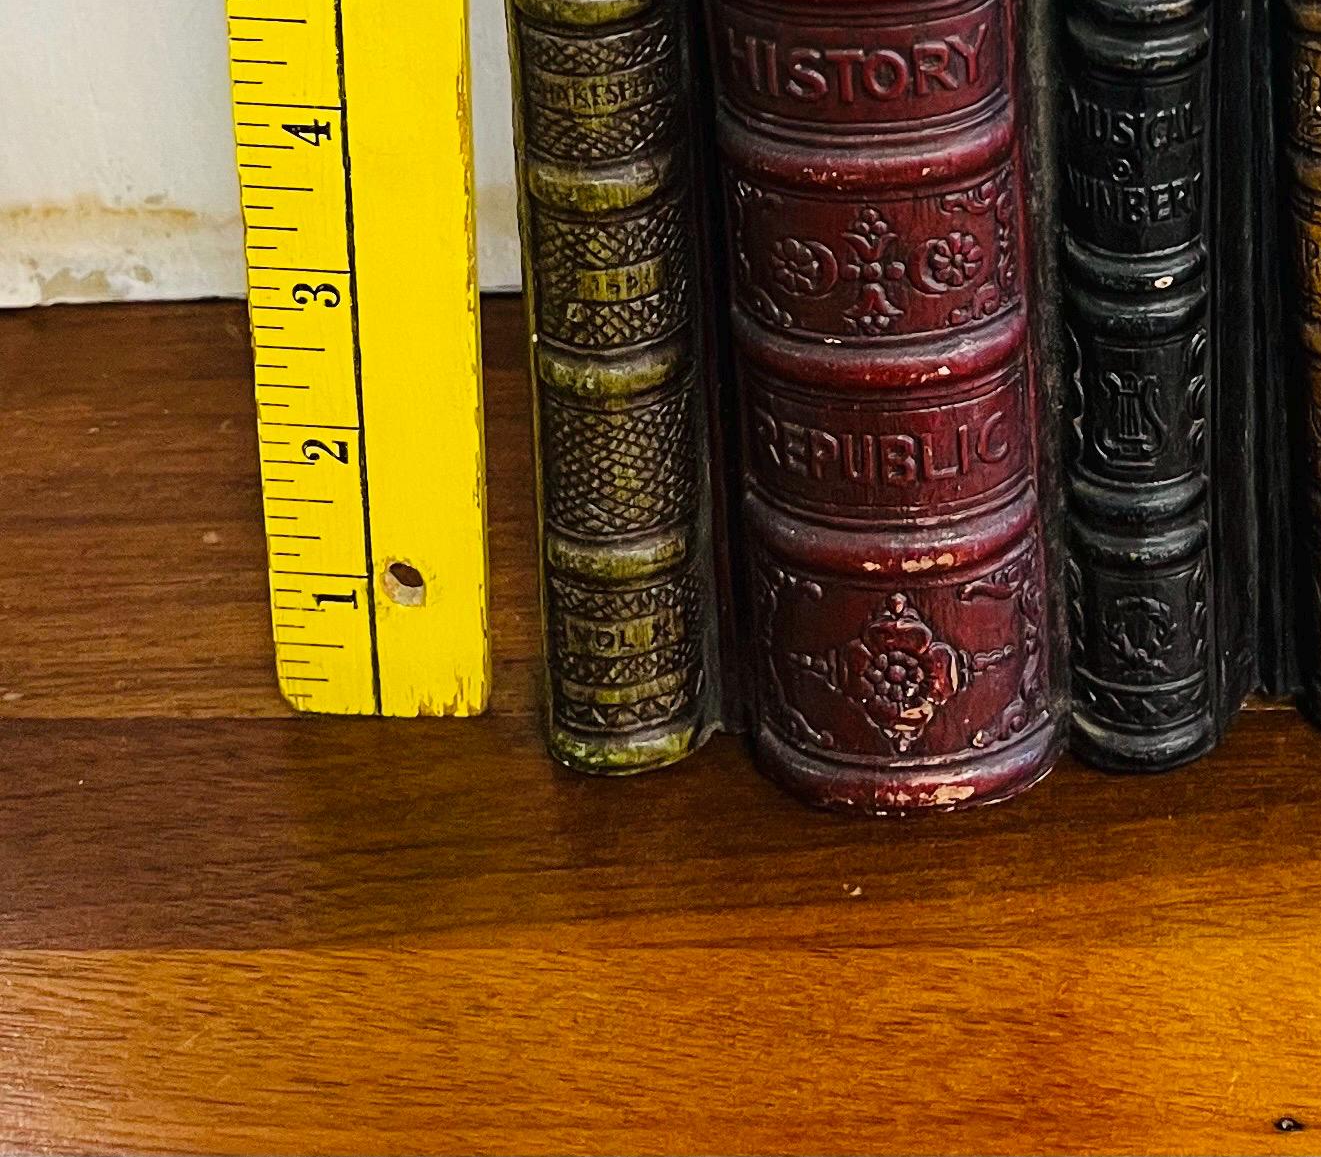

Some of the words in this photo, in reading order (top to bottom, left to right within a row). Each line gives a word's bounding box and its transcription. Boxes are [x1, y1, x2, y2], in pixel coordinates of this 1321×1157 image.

[725, 22, 990, 103] HISTORY
[281, 118, 333, 147] 4
[291, 282, 341, 309] 3
[301, 438, 350, 465] 2
[752, 405, 1011, 487] REPUBLIC
[310, 589, 358, 610] 1
